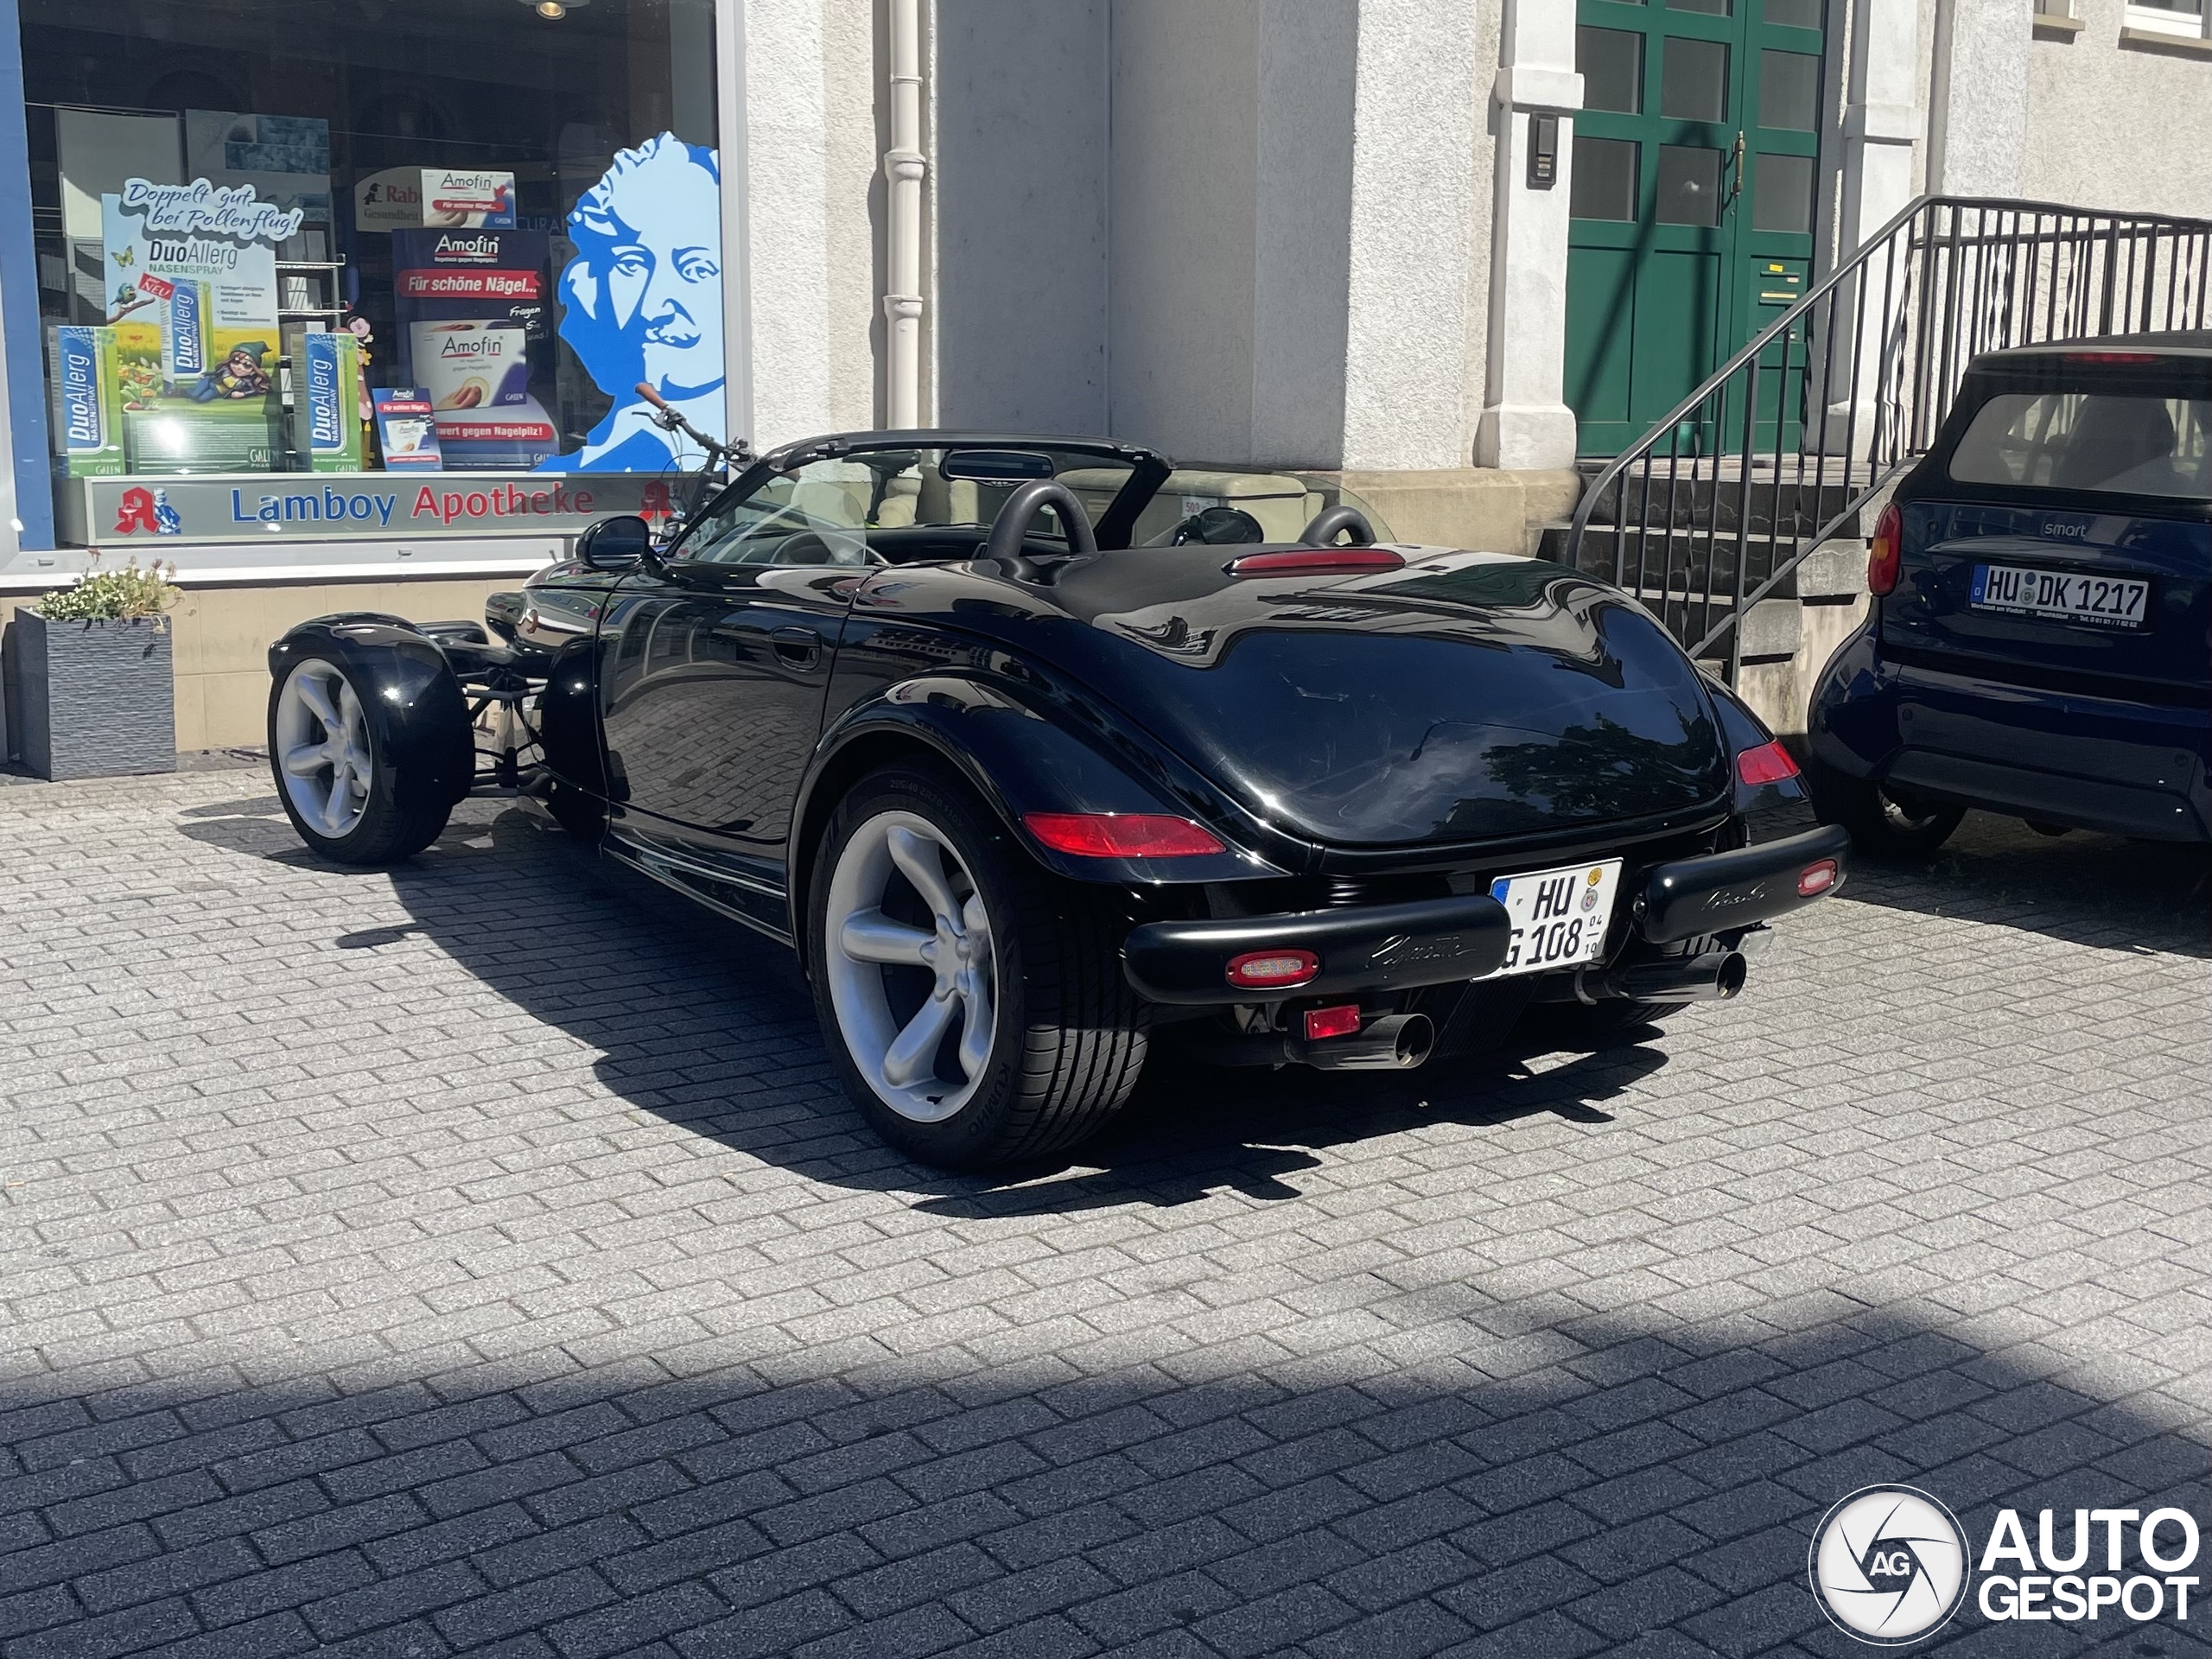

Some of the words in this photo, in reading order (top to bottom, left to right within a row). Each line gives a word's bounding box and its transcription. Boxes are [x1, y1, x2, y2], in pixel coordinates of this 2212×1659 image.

[128, 184, 209, 208] Doppelt
[387, 185, 422, 204] Rab
[151, 206, 181, 225] bei
[186, 209, 302, 235] Pollenflug!
[149, 239, 238, 270] DuoAllerg
[149, 264, 224, 276] NASENSPRAY
[141, 281, 172, 296] NEU
[408, 276, 429, 291] Für
[430, 276, 481, 292] schöne
[486, 277, 537, 295] Nägel...
[508, 305, 542, 319] Fragen
[174, 293, 194, 369] DuoAllerg
[64, 353, 91, 442] DuoAllerg
[309, 358, 334, 442] DuoAllerg
[86, 385, 99, 442] NASENSPRAY
[330, 388, 340, 442] NASENSPRAY
[461, 428, 492, 438] gegen
[231, 486, 397, 527] Lamboy
[411, 481, 594, 525] Apotheke
[2044, 523, 2087, 537] smart
[1987, 569, 2020, 601] HU
[2037, 575, 2071, 607] DK
[2075, 580, 2145, 616] 1217
[1531, 875, 1577, 921] HU
